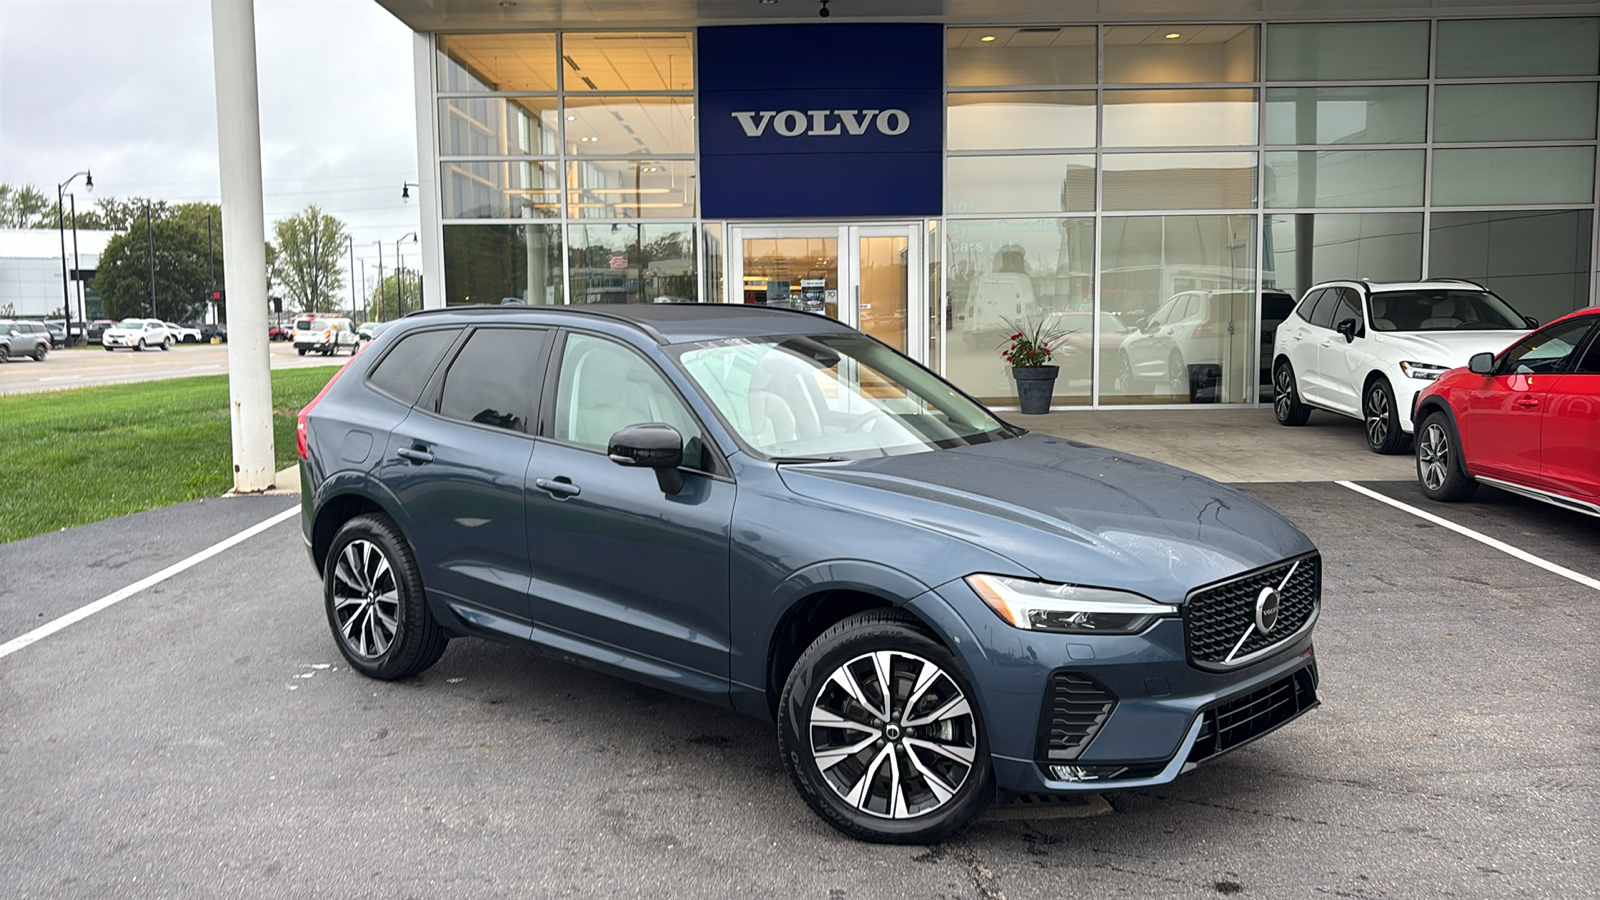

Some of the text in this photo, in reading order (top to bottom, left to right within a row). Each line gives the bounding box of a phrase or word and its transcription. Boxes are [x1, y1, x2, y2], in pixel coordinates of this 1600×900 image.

[731, 109, 910, 137] VOLVO
[948, 240, 984, 253] Cars
[791, 751, 816, 795] ZERO
